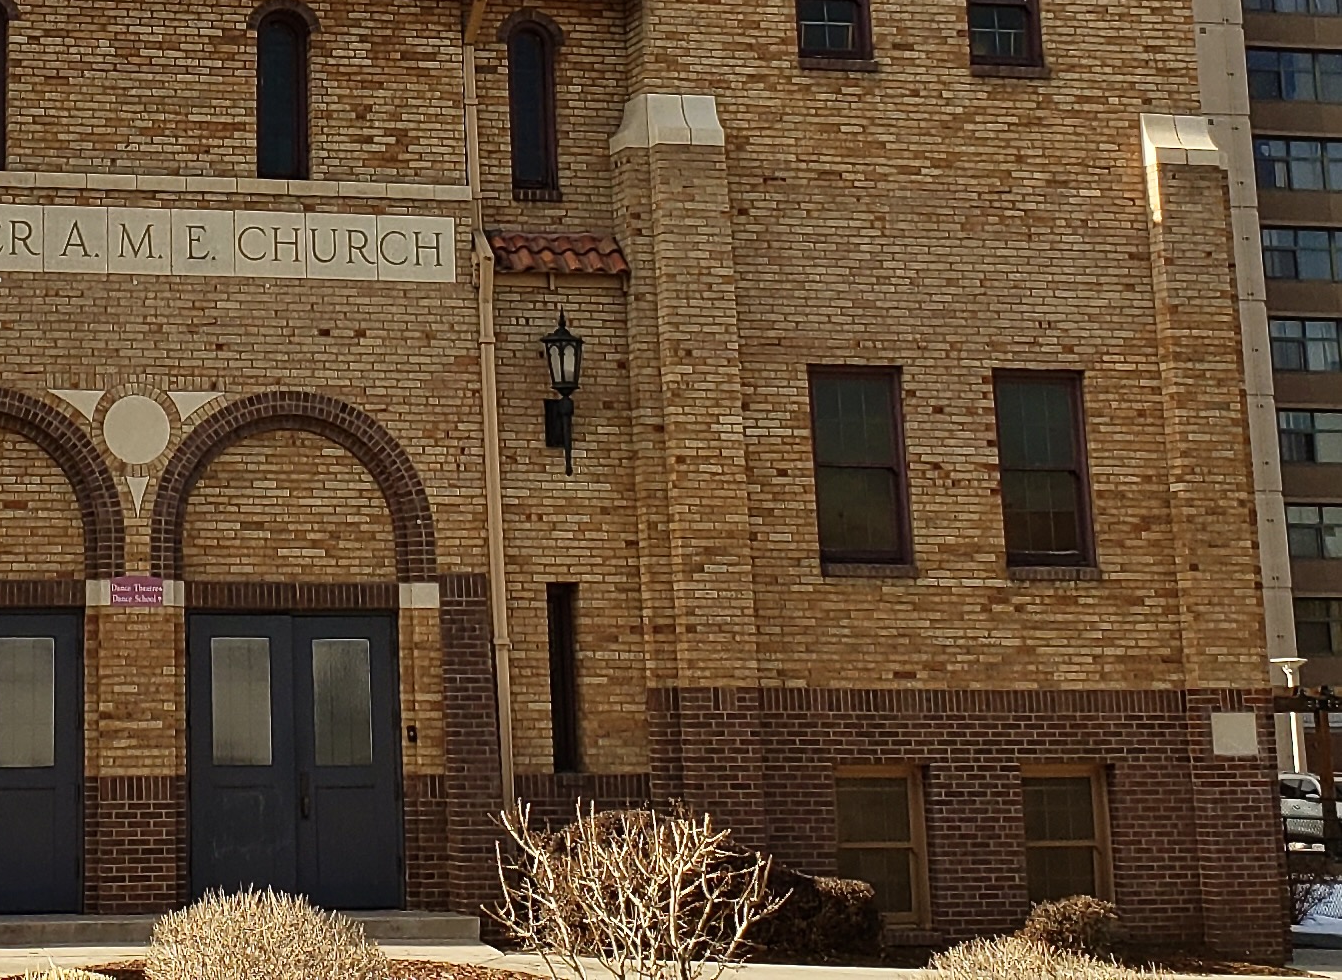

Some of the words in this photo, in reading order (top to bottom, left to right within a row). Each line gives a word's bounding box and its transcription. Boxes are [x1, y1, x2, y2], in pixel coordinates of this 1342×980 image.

[59, 220, 100, 258] A.
[117, 223, 164, 259] M.
[186, 225, 217, 261] E.
[237, 226, 444, 267] CHURCH
[111, 583, 131, 592] Dance
[112, 594, 133, 603] Dance
[134, 594, 156, 603] School
